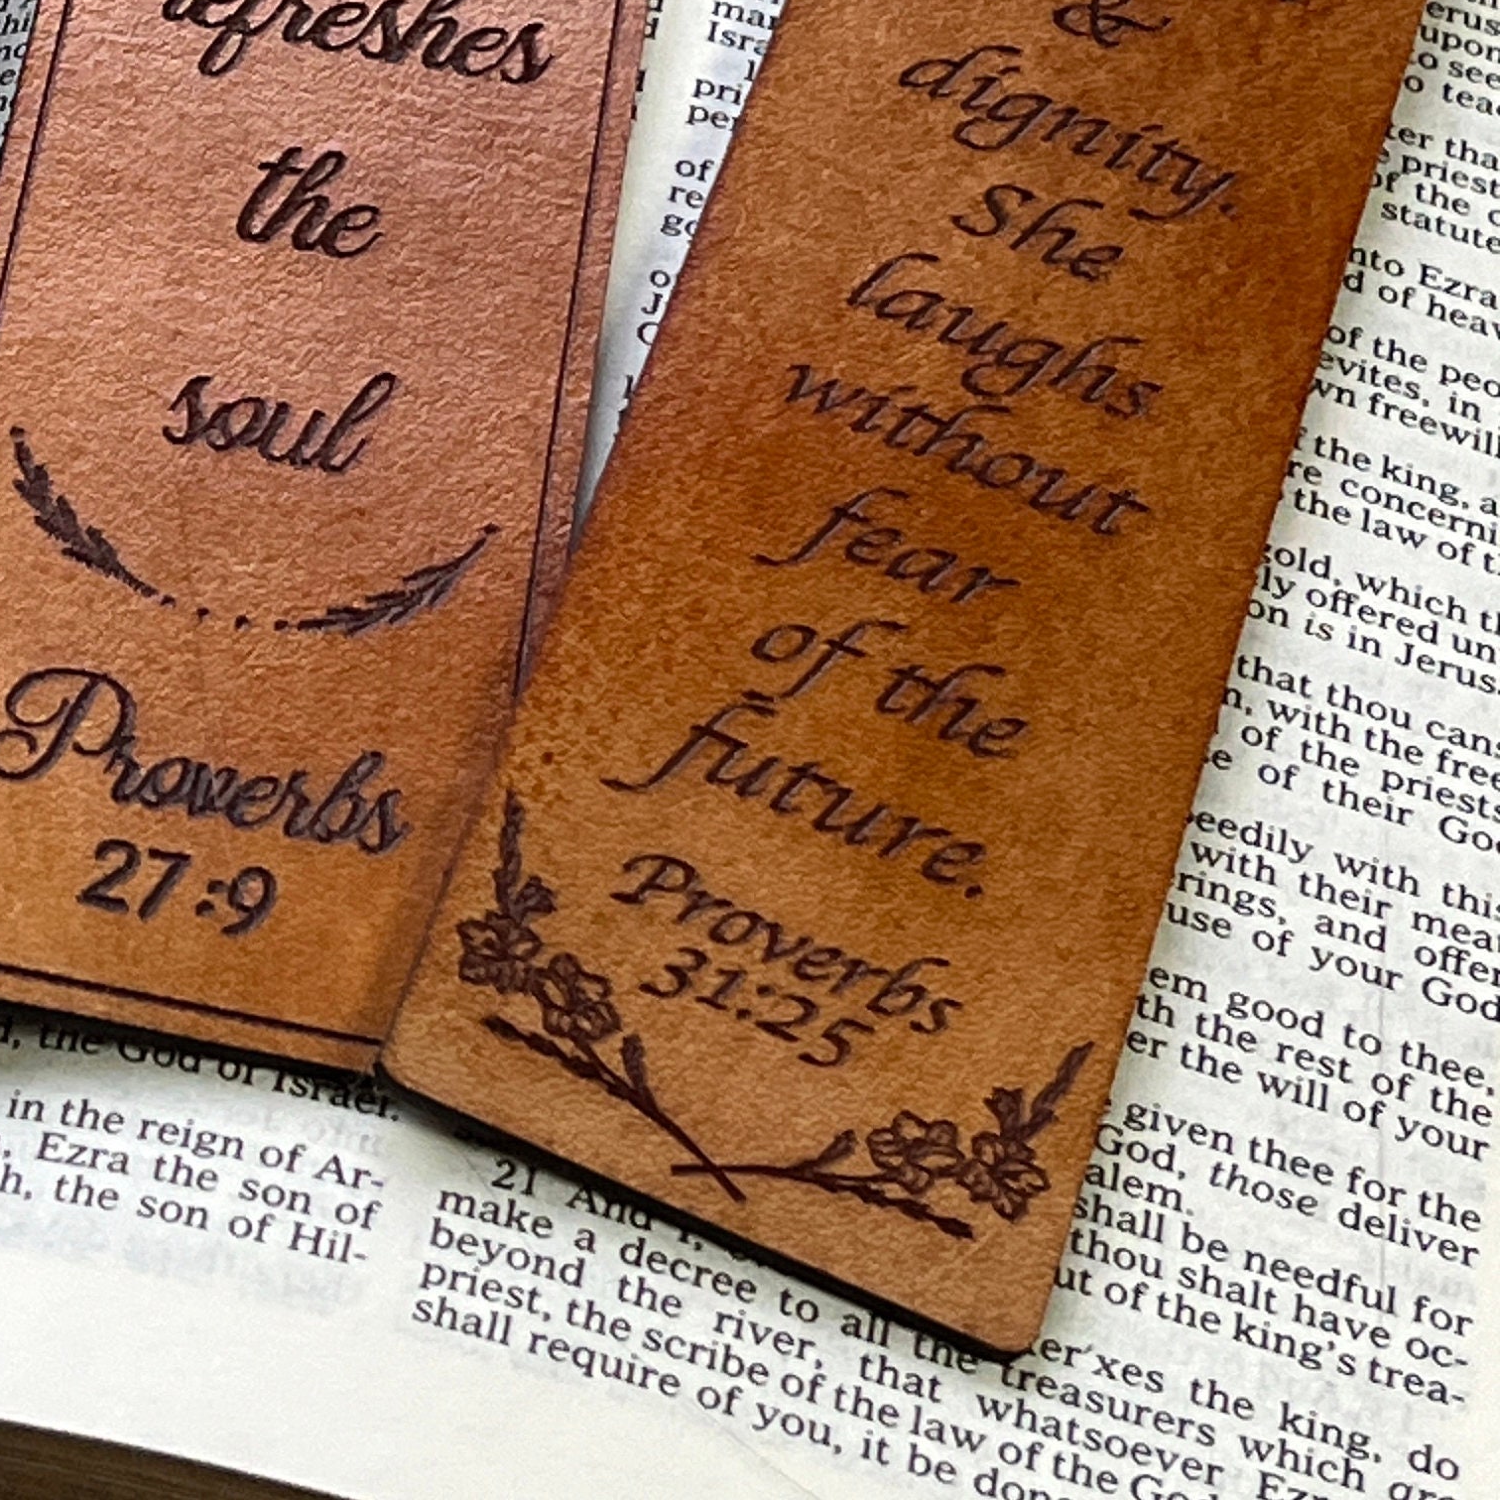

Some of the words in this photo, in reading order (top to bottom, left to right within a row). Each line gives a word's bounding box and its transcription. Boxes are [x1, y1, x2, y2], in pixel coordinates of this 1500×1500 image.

[899, 43, 1238, 224] dignity.
[234, 144, 385, 260] the
[951, 181, 1127, 285] She
[847, 251, 1164, 423] laughs
[162, 371, 397, 474] soul
[782, 361, 1151, 539] without
[1382, 455, 1469, 509] king,
[754, 486, 1020, 607] fear
[1306, 589, 1438, 644] offered
[741, 619, 907, 704] of
[875, 662, 1031, 761] the
[600, 700, 988, 901] future.
[74, 838, 280, 938] 27:9
[1192, 839, 1277, 886] with
[1299, 871, 1393, 920] their
[1315, 912, 1387, 952] and
[611, 852, 963, 1035] Proverbs
[639, 944, 875, 1068] 31:25
[1227, 991, 1323, 1039] good
[1343, 1023, 1382, 1056] to
[6, 1090, 45, 1125] in
[59, 1099, 126, 1136] the
[137, 1111, 244, 1160] reign
[260, 1141, 304, 1172] of
[315, 1154, 385, 1192] Ar-
[36, 1132, 130, 1175] Ezra
[152, 1154, 220, 1192] the
[238, 1176, 311, 1215] son
[335, 1199, 382, 1231] of
[491, 1161, 535, 1195] 21
[1094, 1123, 1187, 1179] God,
[1209, 1160, 1319, 1216] those
[1338, 1203, 1479, 1269] deliver
[1123, 1102, 1235, 1155] given
[1248, 1134, 1334, 1185] thee
[1346, 1166, 1406, 1207] for
[1418, 1192, 1482, 1233] the
[54, 1174, 120, 1211] the
[137, 1196, 208, 1231] son
[228, 1214, 276, 1246] of
[289, 1221, 369, 1265] Hil-
[437, 1189, 555, 1240] make
[574, 1229, 596, 1252] a
[620, 1239, 757, 1304] decree
[779, 1288, 819, 1324] to
[1072, 1194, 1165, 1243] shall
[1181, 1222, 1229, 1263] be
[1244, 1249, 1397, 1316] needful
[1413, 1296, 1473, 1337] for
[1070, 1227, 1164, 1280] thou
[1178, 1264, 1279, 1316] shalt
[1295, 1298, 1392, 1349] have
[412, 1297, 513, 1346] shall
[528, 1331, 681, 1397] require
[696, 1385, 741, 1415] of
[752, 1401, 843, 1455] you,
[862, 1432, 890, 1466] it
[420, 1261, 550, 1322] priest,
[566, 1299, 632, 1343] the
[642, 1326, 770, 1386] scribe
[782, 1371, 824, 1404] of
[833, 1382, 901, 1427] the
[909, 1407, 987, 1455] law
[429, 1218, 586, 1289] beyond
[617, 1274, 684, 1318] the
[713, 1308, 824, 1369] river,
[859, 1354, 943, 1404] that
[978, 1392, 1224, 1486] whatsoever
